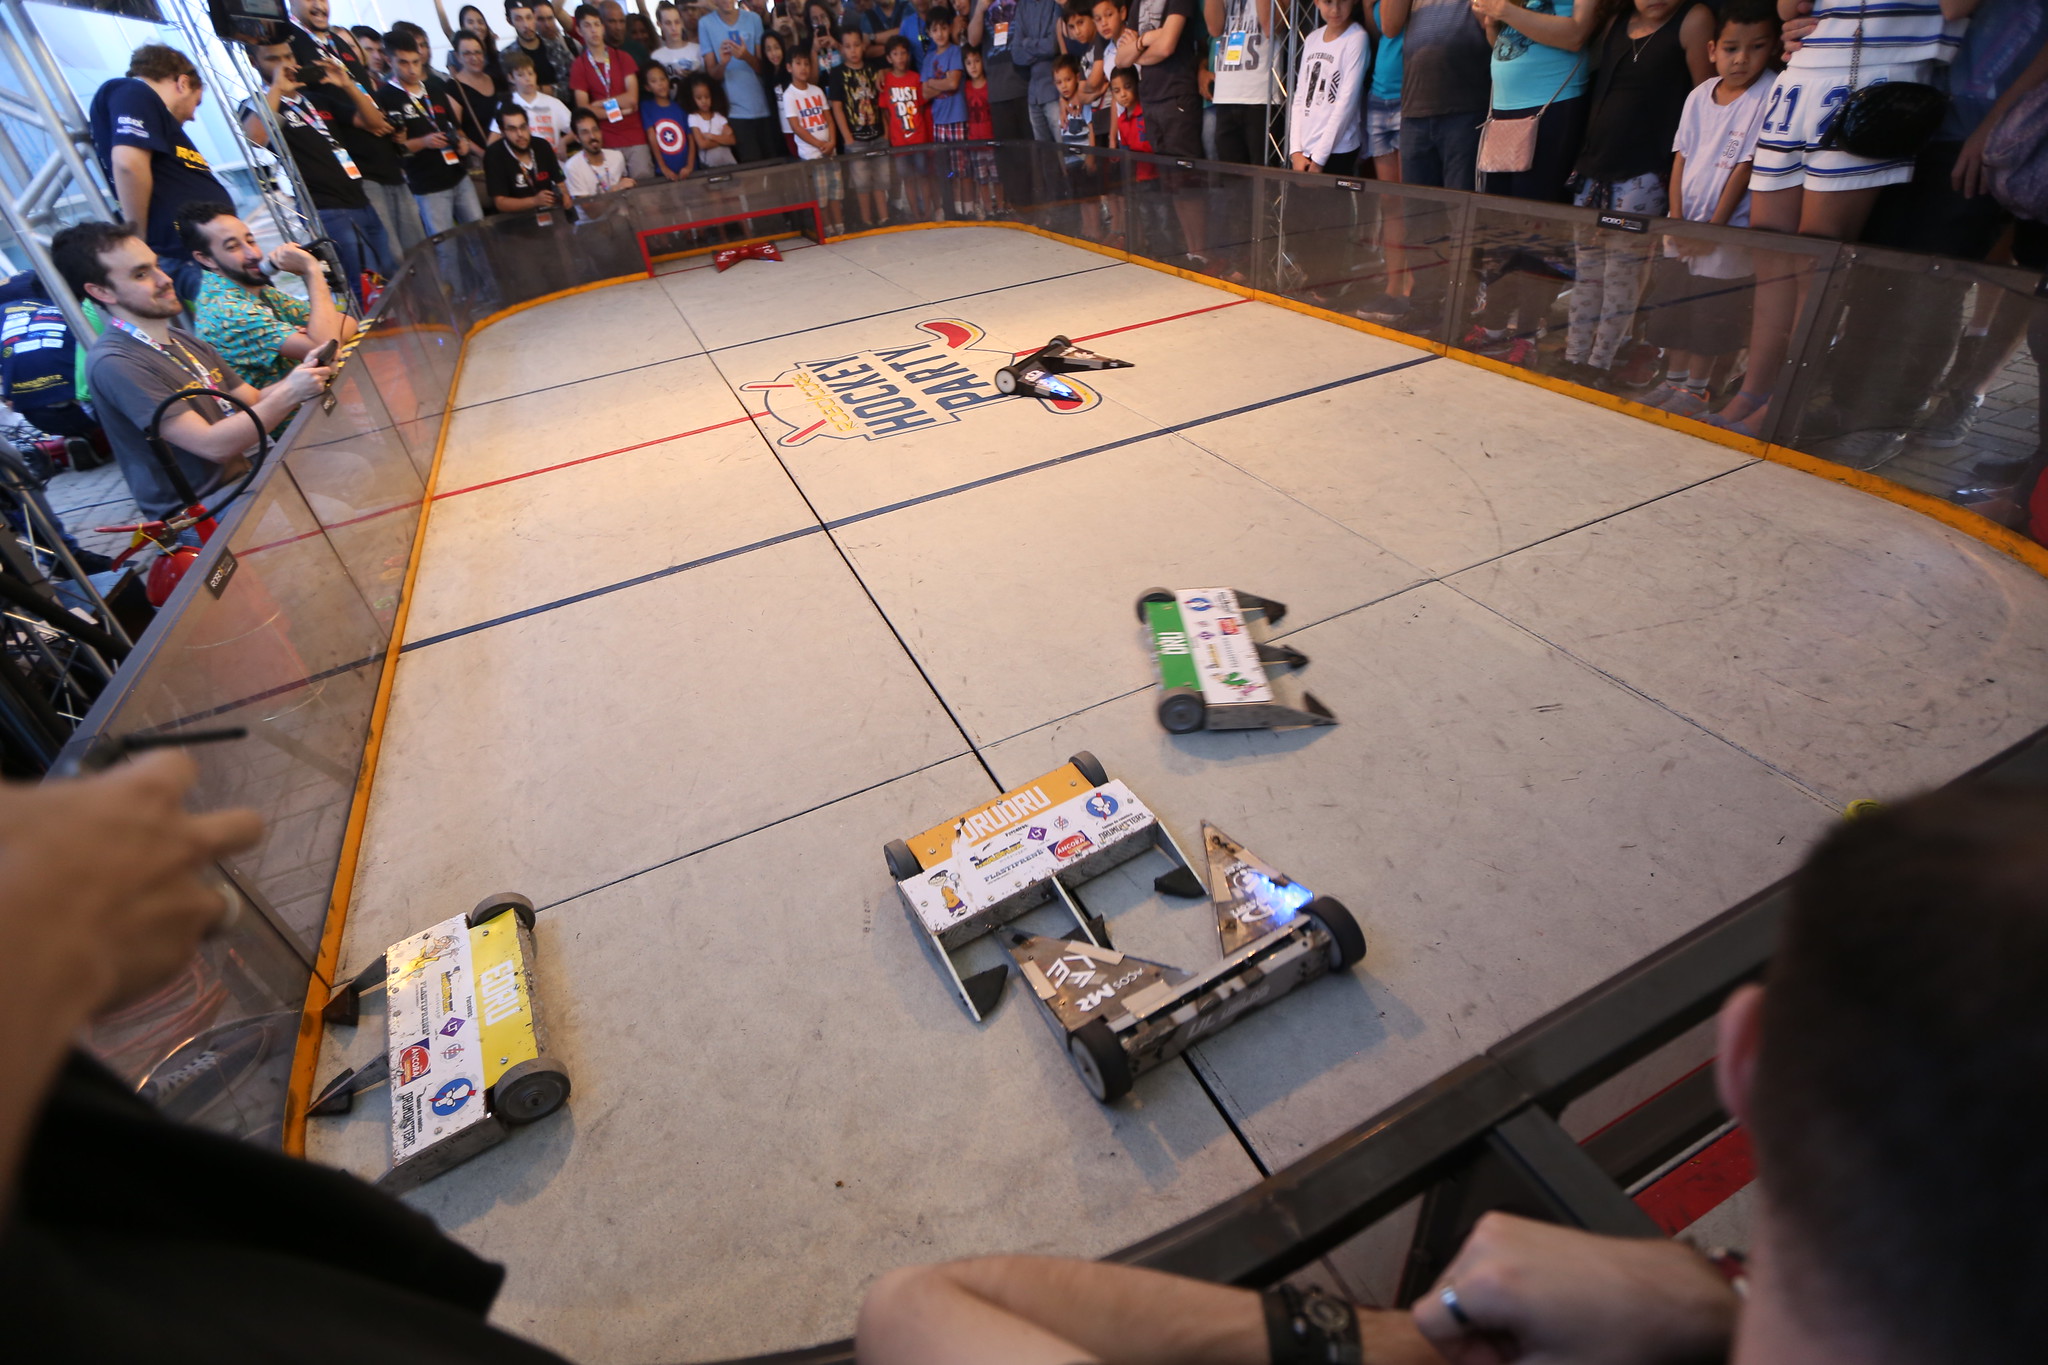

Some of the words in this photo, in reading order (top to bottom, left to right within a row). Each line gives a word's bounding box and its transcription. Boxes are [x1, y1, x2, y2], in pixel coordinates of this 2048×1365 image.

[890, 86, 918, 102] JUST
[896, 101, 918, 117] DO
[1762, 84, 1802, 135] 21
[902, 115, 915, 130] IT
[806, 355, 937, 435] HOCKEY
[872, 343, 1008, 412] PARTY
[480, 959, 521, 1026] EDRU
